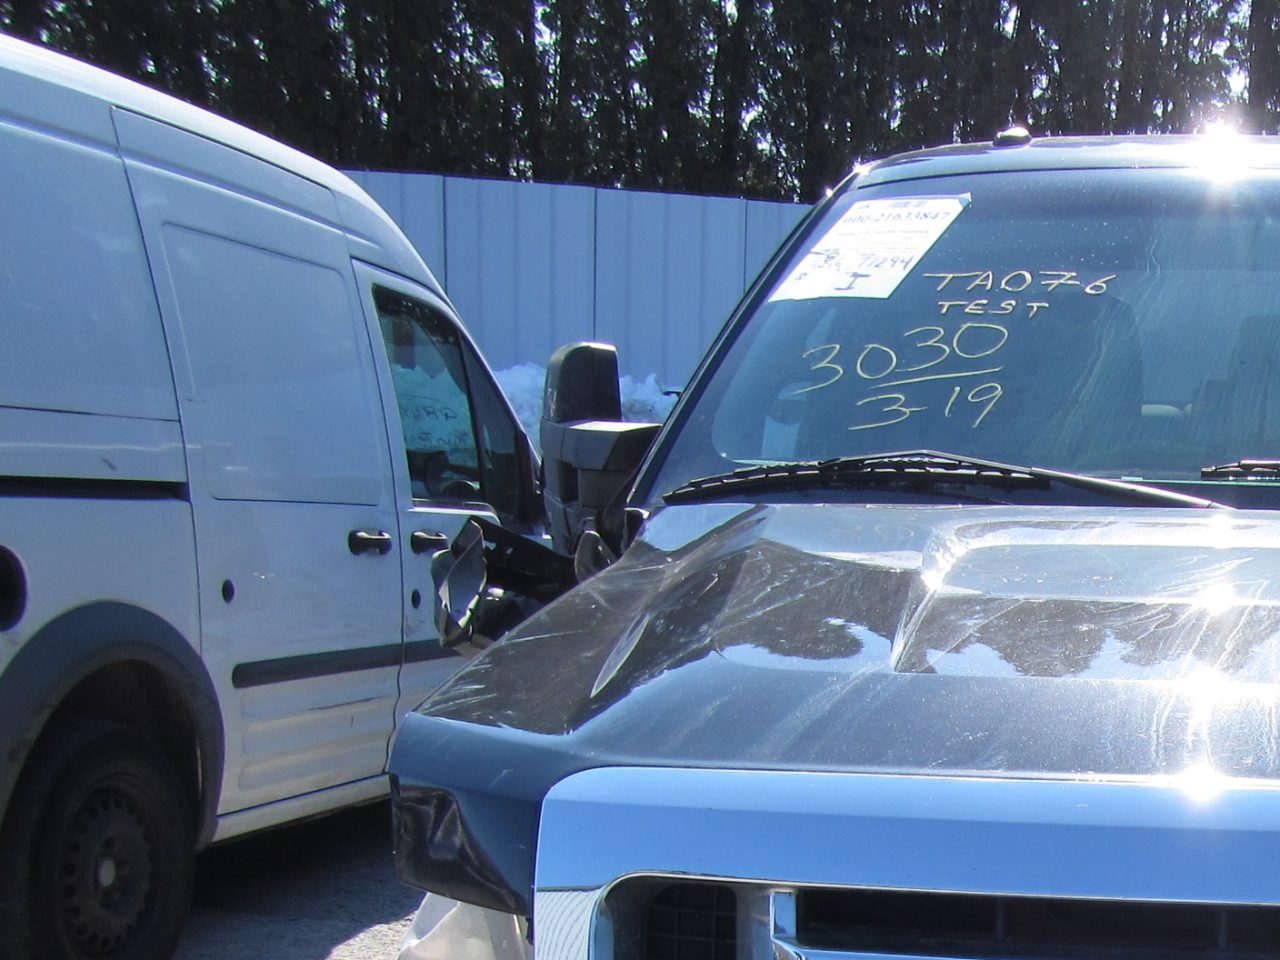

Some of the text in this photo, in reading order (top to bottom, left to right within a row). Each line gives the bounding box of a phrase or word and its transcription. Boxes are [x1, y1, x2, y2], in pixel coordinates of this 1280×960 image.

[937, 300, 1050, 319] TEST
[788, 323, 1009, 395] 3030
[848, 382, 1004, 431] 3-19
